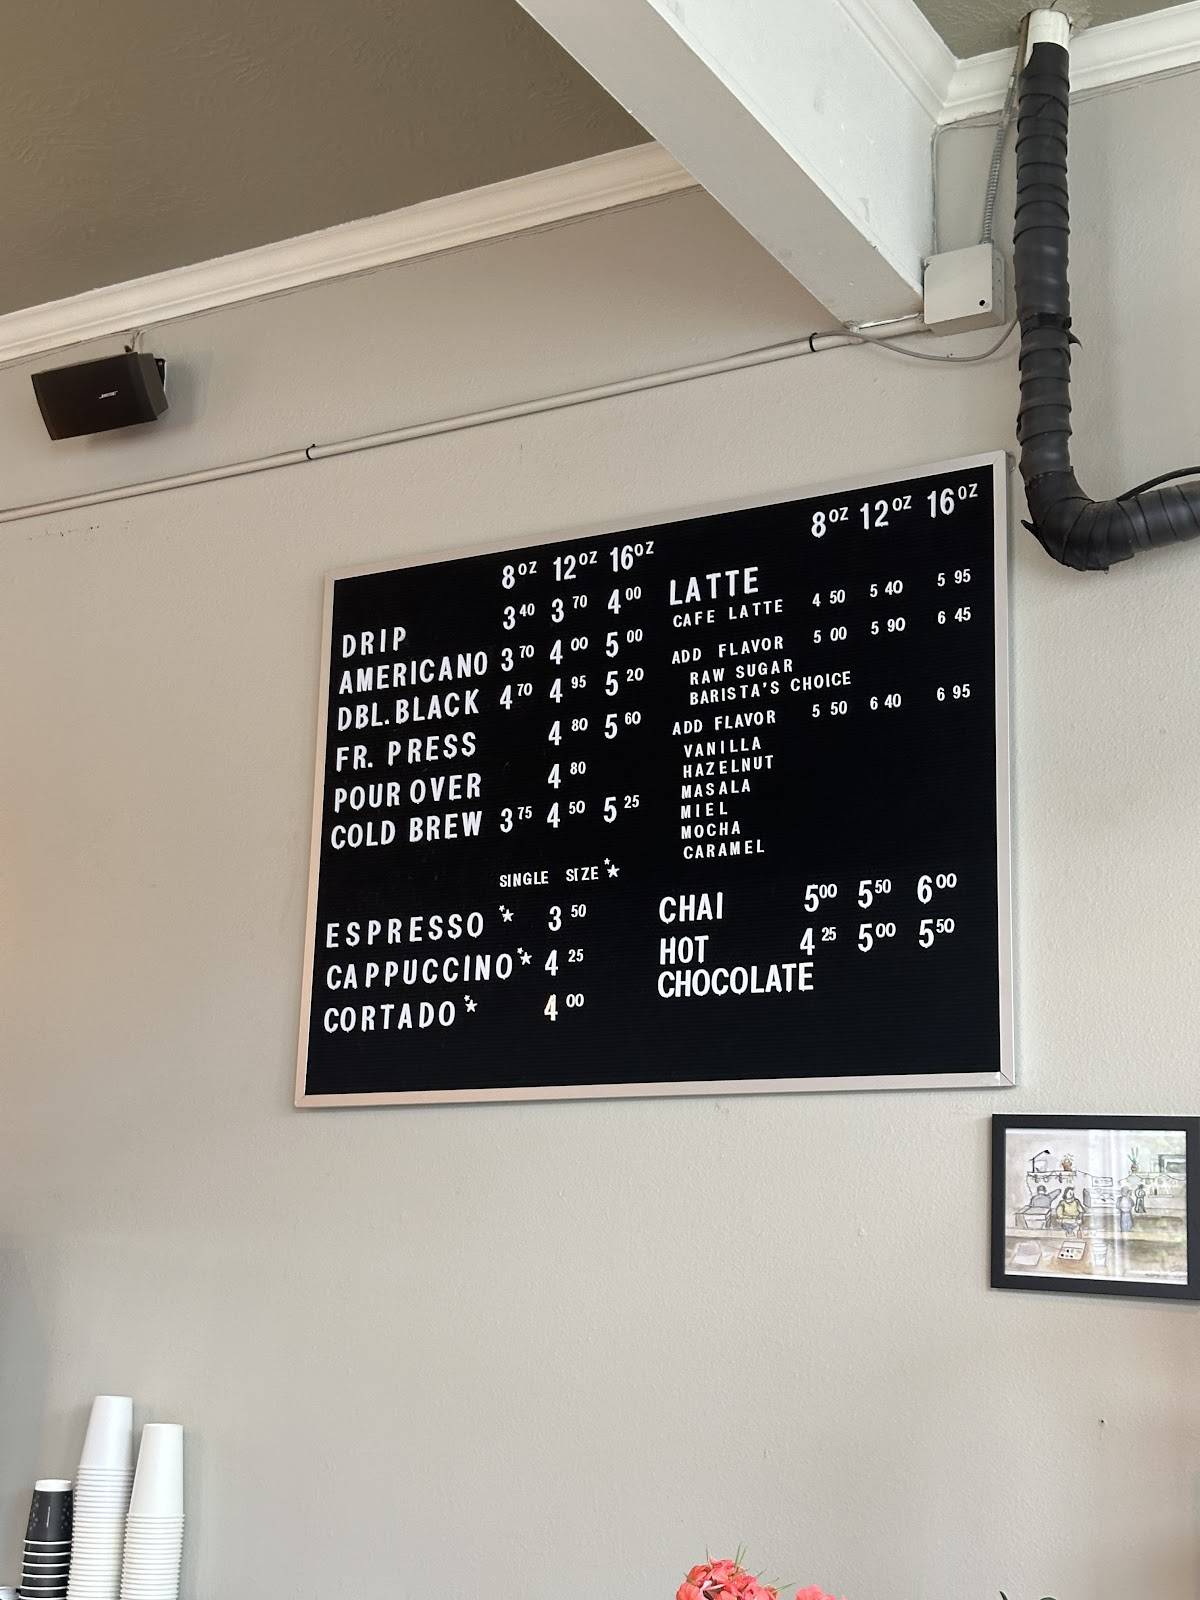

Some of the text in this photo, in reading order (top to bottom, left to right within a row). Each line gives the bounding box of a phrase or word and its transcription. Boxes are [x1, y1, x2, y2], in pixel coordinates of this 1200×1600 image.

[670, 567, 758, 605] LATTE
[673, 610, 715, 627] CAFE
[729, 599, 782, 620] LATTE
[343, 627, 406, 658] DRIP
[672, 648, 701, 664] ADD
[719, 636, 783, 658] FLAVOR
[339, 651, 487, 694] AMERICANO
[690, 659, 792, 685] RAW SUGAR
[690, 671, 851, 705] BARISTA'S CHOICE
[338, 702, 389, 731] DBL.
[396, 689, 479, 724] BLACK
[672, 719, 702, 735] ADD
[715, 710, 775, 730] FLAVOR
[336, 745, 373, 772] FR.
[388, 732, 476, 766] PRESS
[684, 737, 761, 758] VANILLA
[683, 755, 773, 778] HAZELNUT
[335, 782, 400, 813] POUR
[410, 773, 481, 804] OVER
[682, 779, 750, 799] MASALA
[681, 802, 727, 819] MIEL
[331, 820, 395, 849] COLD
[410, 811, 482, 842] BREW
[681, 821, 740, 839] MOCHA
[684, 839, 764, 859] CARAMEL
[500, 866, 598, 887] SINGLE SIZE
[659, 892, 723, 924] CHAI
[326, 912, 483, 948] ESPRESSO
[660, 935, 709, 965] HOT
[327, 954, 512, 990] CAPPUCCINO
[658, 962, 813, 998] CHOCOLATE
[324, 1001, 455, 1033] CORTADO
